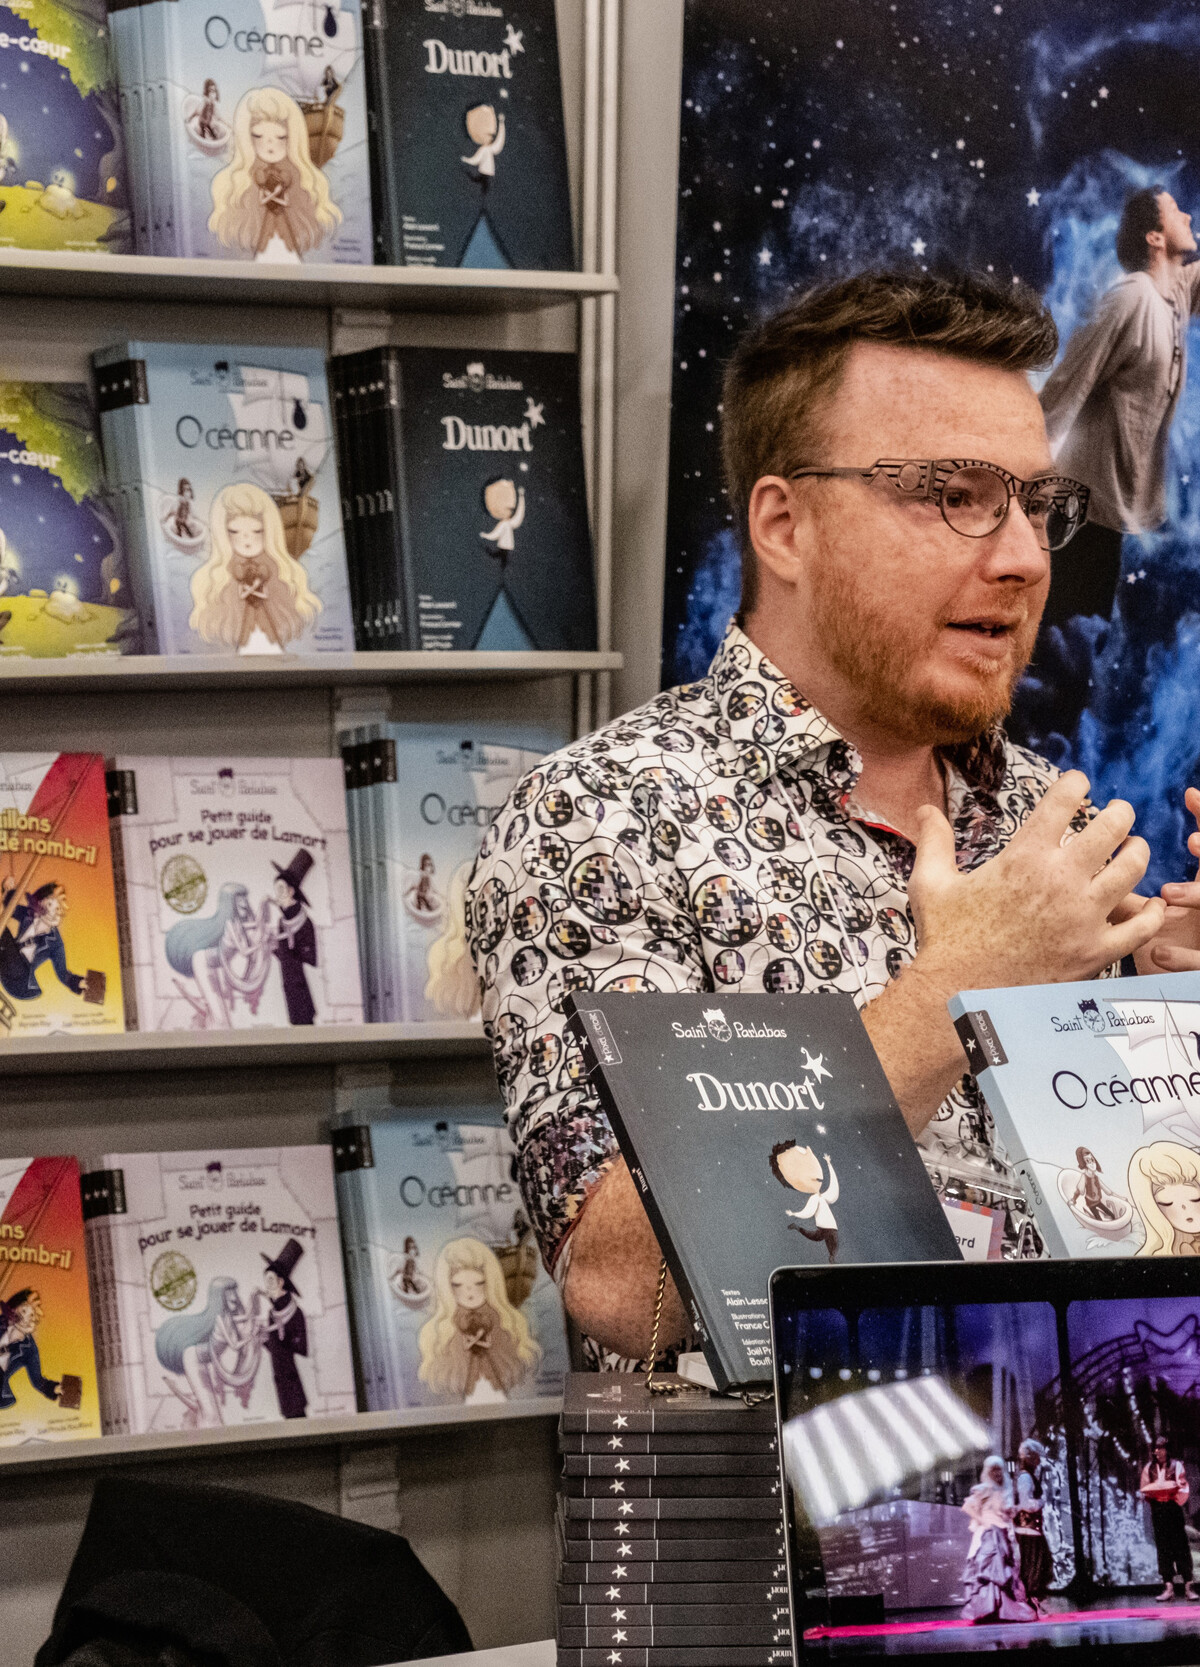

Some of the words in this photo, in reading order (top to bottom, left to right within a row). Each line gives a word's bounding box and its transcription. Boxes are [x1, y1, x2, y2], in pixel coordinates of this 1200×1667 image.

[205, 15, 324, 57] Océanne
[422, 38, 513, 79] Dunort
[176, 415, 296, 451] Océanne
[440, 415, 533, 452] Dunort
[0, 808, 51, 833] illons
[201, 809, 234, 823] Petit
[237, 810, 271, 825] guide
[24, 838, 97, 865] nombril
[150, 833, 183, 855] pour
[187, 830, 204, 843] se
[206, 825, 246, 845] jouer
[250, 826, 268, 840] de
[272, 826, 327, 849] Lamort
[671, 1022, 707, 1038] Saint
[733, 1021, 787, 1038] Parlabas
[1050, 1015, 1083, 1032] Saint
[1106, 1010, 1155, 1028] Parlabas
[685, 1072, 825, 1111] Dunort
[189, 1204, 221, 1218] Petit
[225, 1202, 261, 1219] guide
[138, 1229, 172, 1255] pour
[177, 1225, 193, 1239] se
[195, 1220, 235, 1240] jouer
[239, 1218, 257, 1233] de
[261, 1217, 316, 1239] Lamort
[726, 1297, 745, 1306] Alain
[734, 1321, 763, 1330] France
[749, 1357, 772, 1366] Bouff
